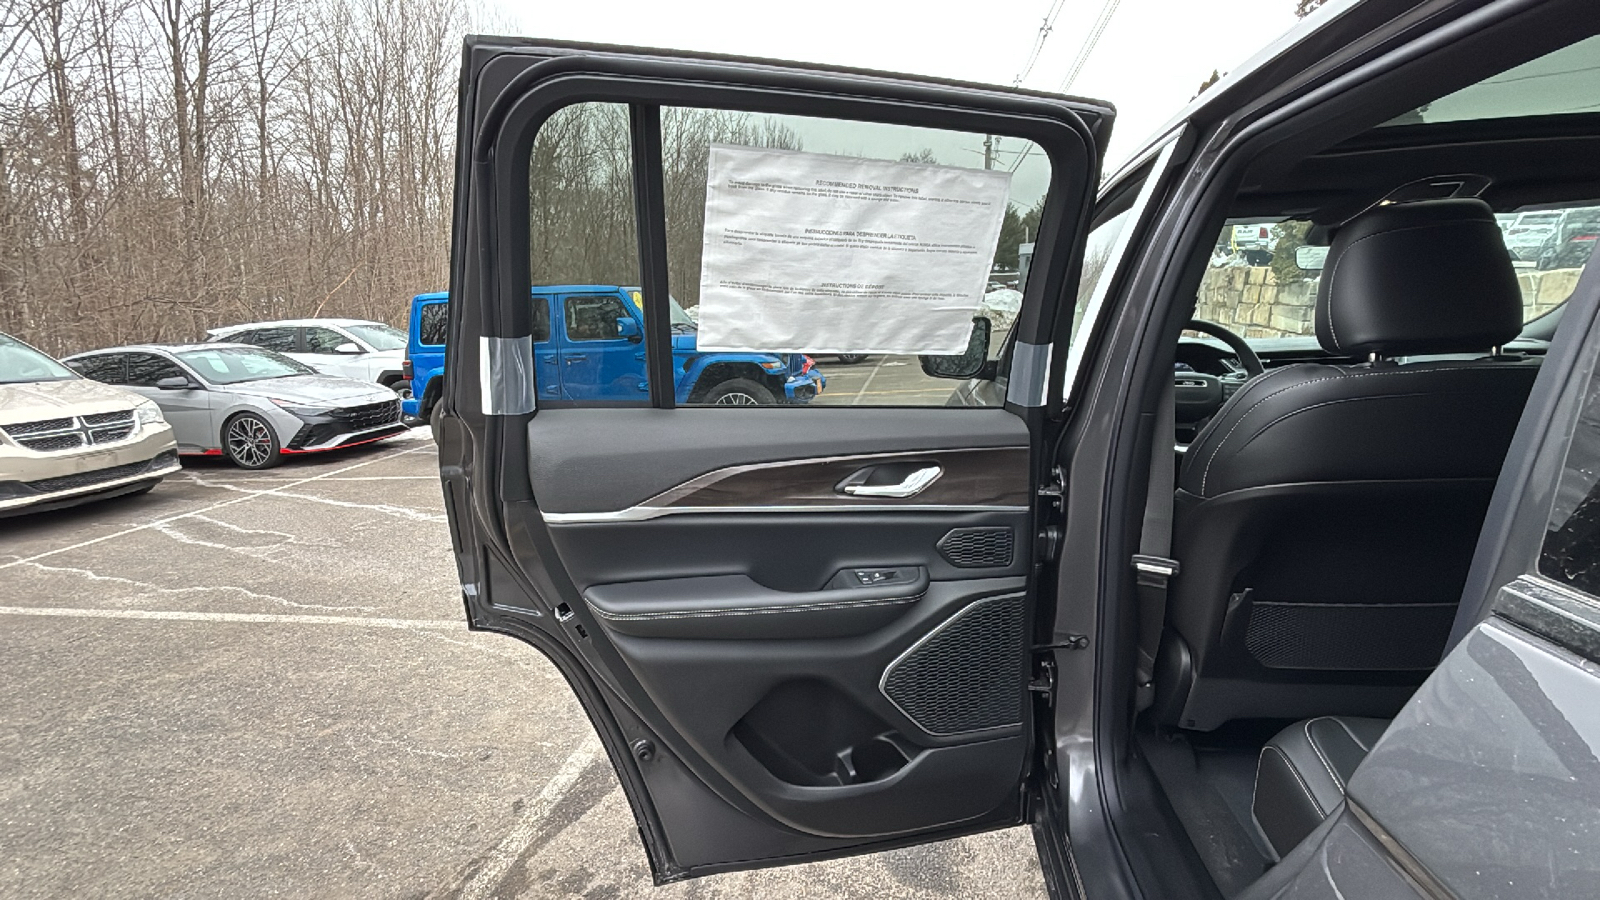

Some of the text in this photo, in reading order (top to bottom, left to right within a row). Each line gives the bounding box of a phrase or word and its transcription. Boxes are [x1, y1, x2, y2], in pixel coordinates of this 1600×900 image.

[815, 179, 857, 189] RECOMMENDED
[857, 183, 882, 191] REMOVAL
[882, 185, 919, 194] INSTRUCTIONS
